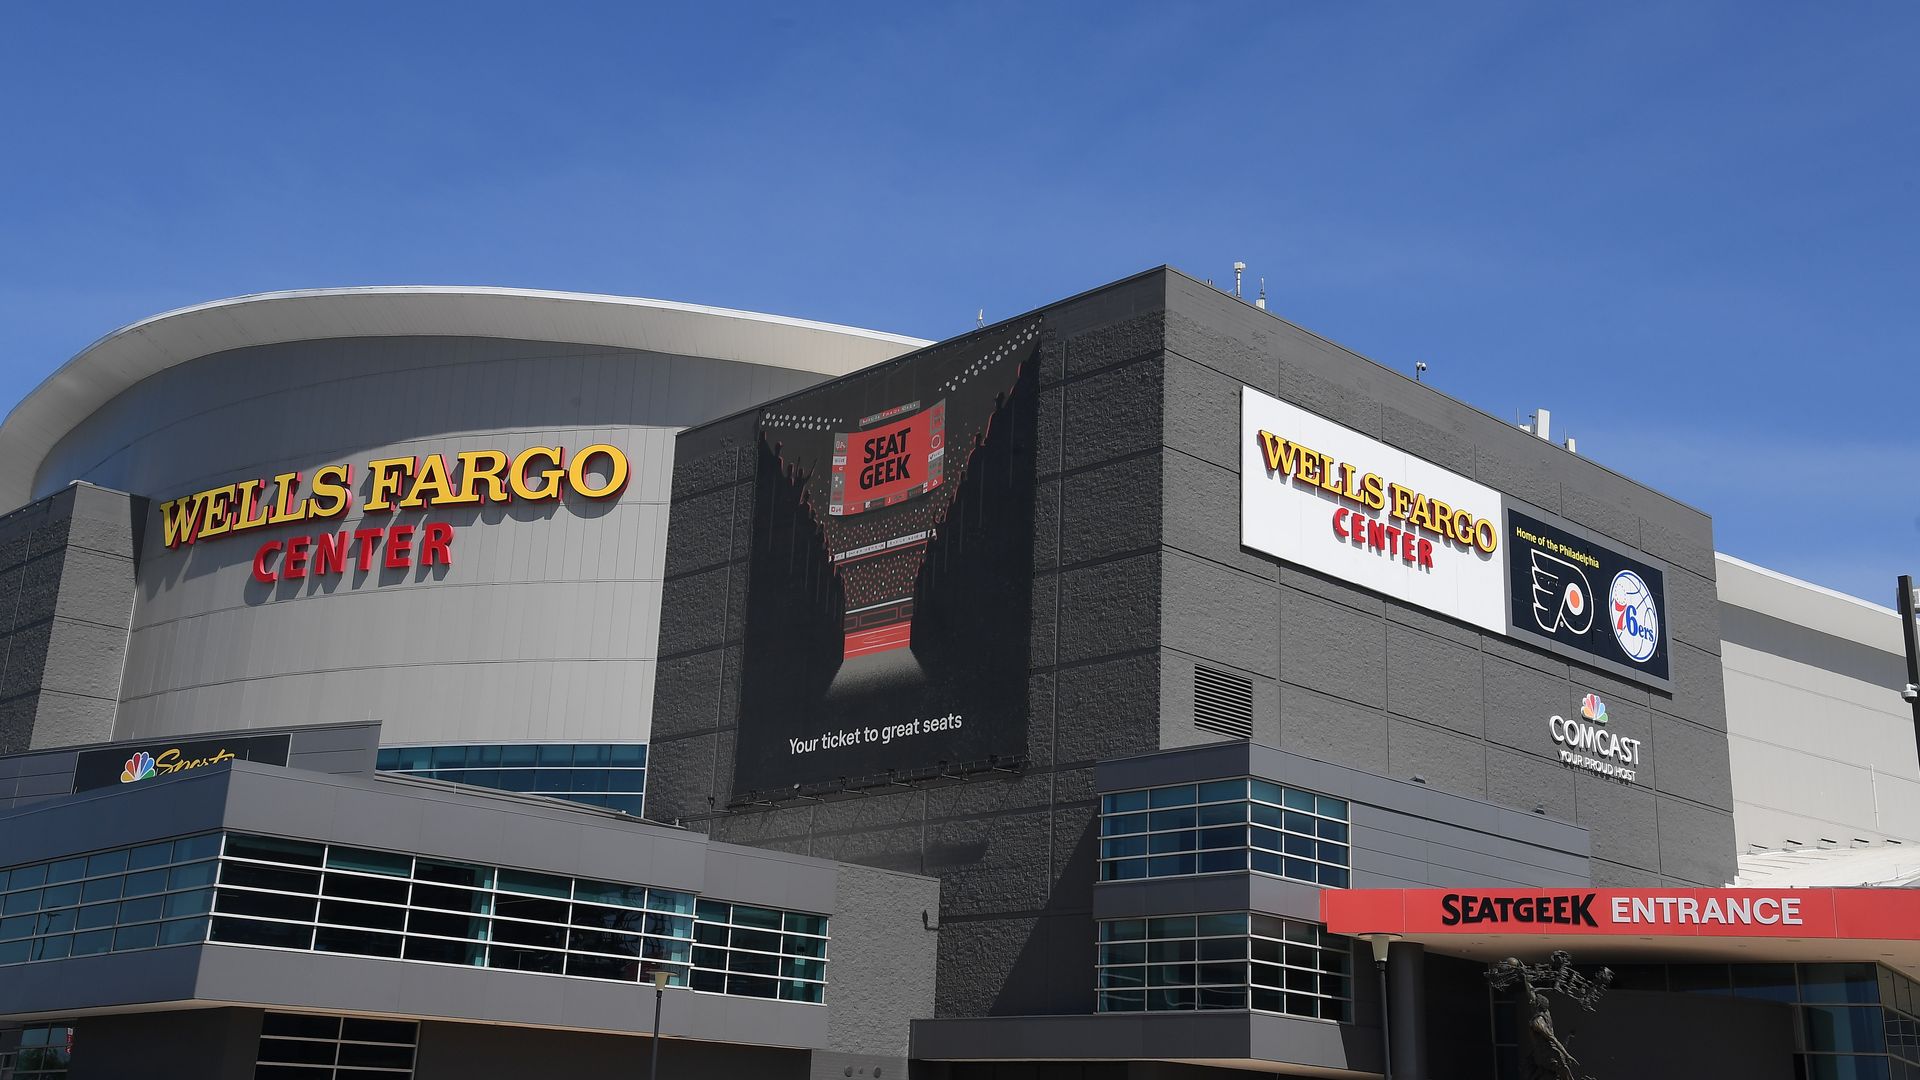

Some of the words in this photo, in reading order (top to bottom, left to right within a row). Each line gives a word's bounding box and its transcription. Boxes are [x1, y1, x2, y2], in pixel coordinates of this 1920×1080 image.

[863, 427, 911, 464] SEAT
[859, 453, 911, 490] GEEK
[1257, 429, 1386, 510] WELLS
[1388, 482, 1498, 553] FARGO
[160, 463, 353, 549] WELLS
[363, 443, 630, 511] FARGO
[251, 521, 454, 584] CENTER
[1333, 507, 1434, 569] CENTER
[1516, 526, 1537, 544] Home
[1537, 536, 1546, 547] of
[1546, 539, 1559, 553] the
[1559, 543, 1600, 569] Philadelphia
[1615, 600, 1654, 641] 76ers
[789, 737, 819, 755] Your
[821, 728, 861, 750] ticket
[864, 726, 879, 742] to
[881, 717, 920, 745] great
[923, 712, 963, 734] seats
[1549, 715, 1641, 766] COMCAST
[1560, 750, 1583, 766] YOUR
[1584, 756, 1614, 775] PROUD
[1614, 765, 1637, 782] HOST
[1441, 893, 1599, 928] SEATGEEK
[1611, 897, 1803, 926] ENTRANCE
